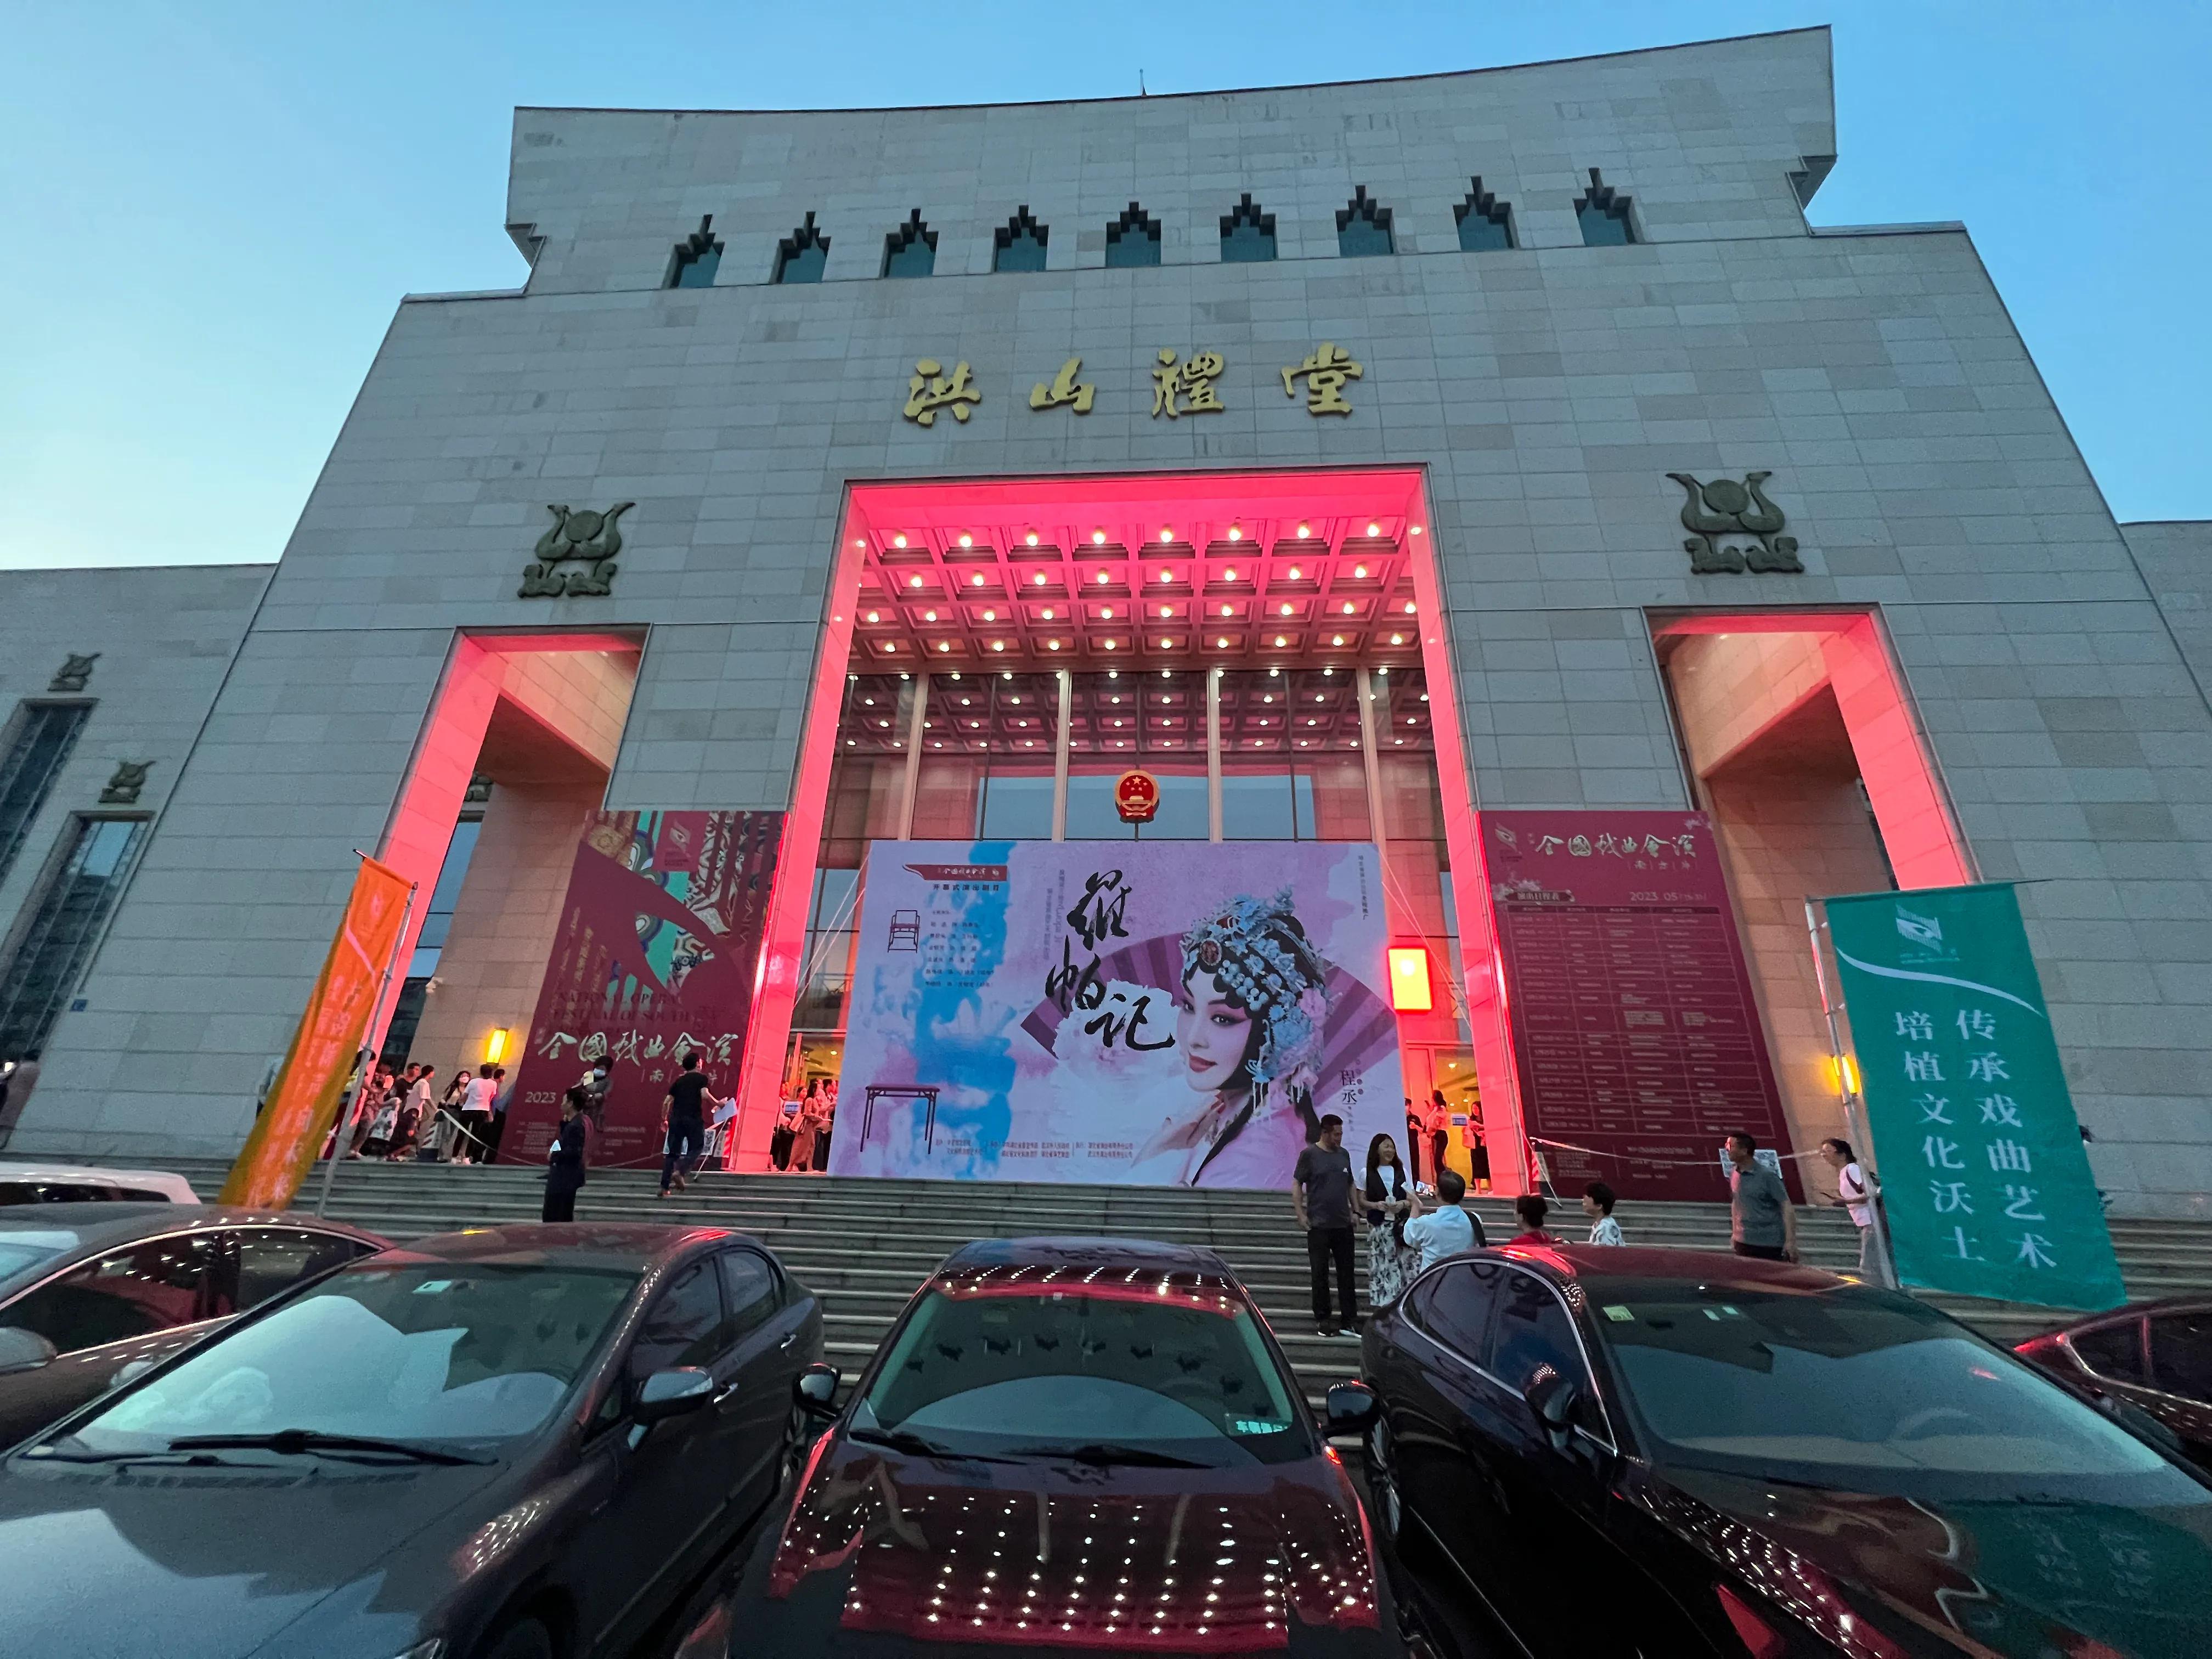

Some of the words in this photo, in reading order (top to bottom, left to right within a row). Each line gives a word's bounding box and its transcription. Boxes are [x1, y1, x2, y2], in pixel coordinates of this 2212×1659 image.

[1629, 891, 1658, 901] 2023
[525, 1091, 556, 1104] 2023
[1895, 1010, 1985, 1261] 培植文化沃土
[1956, 1009, 2058, 1268] 传承戏曲艺术
